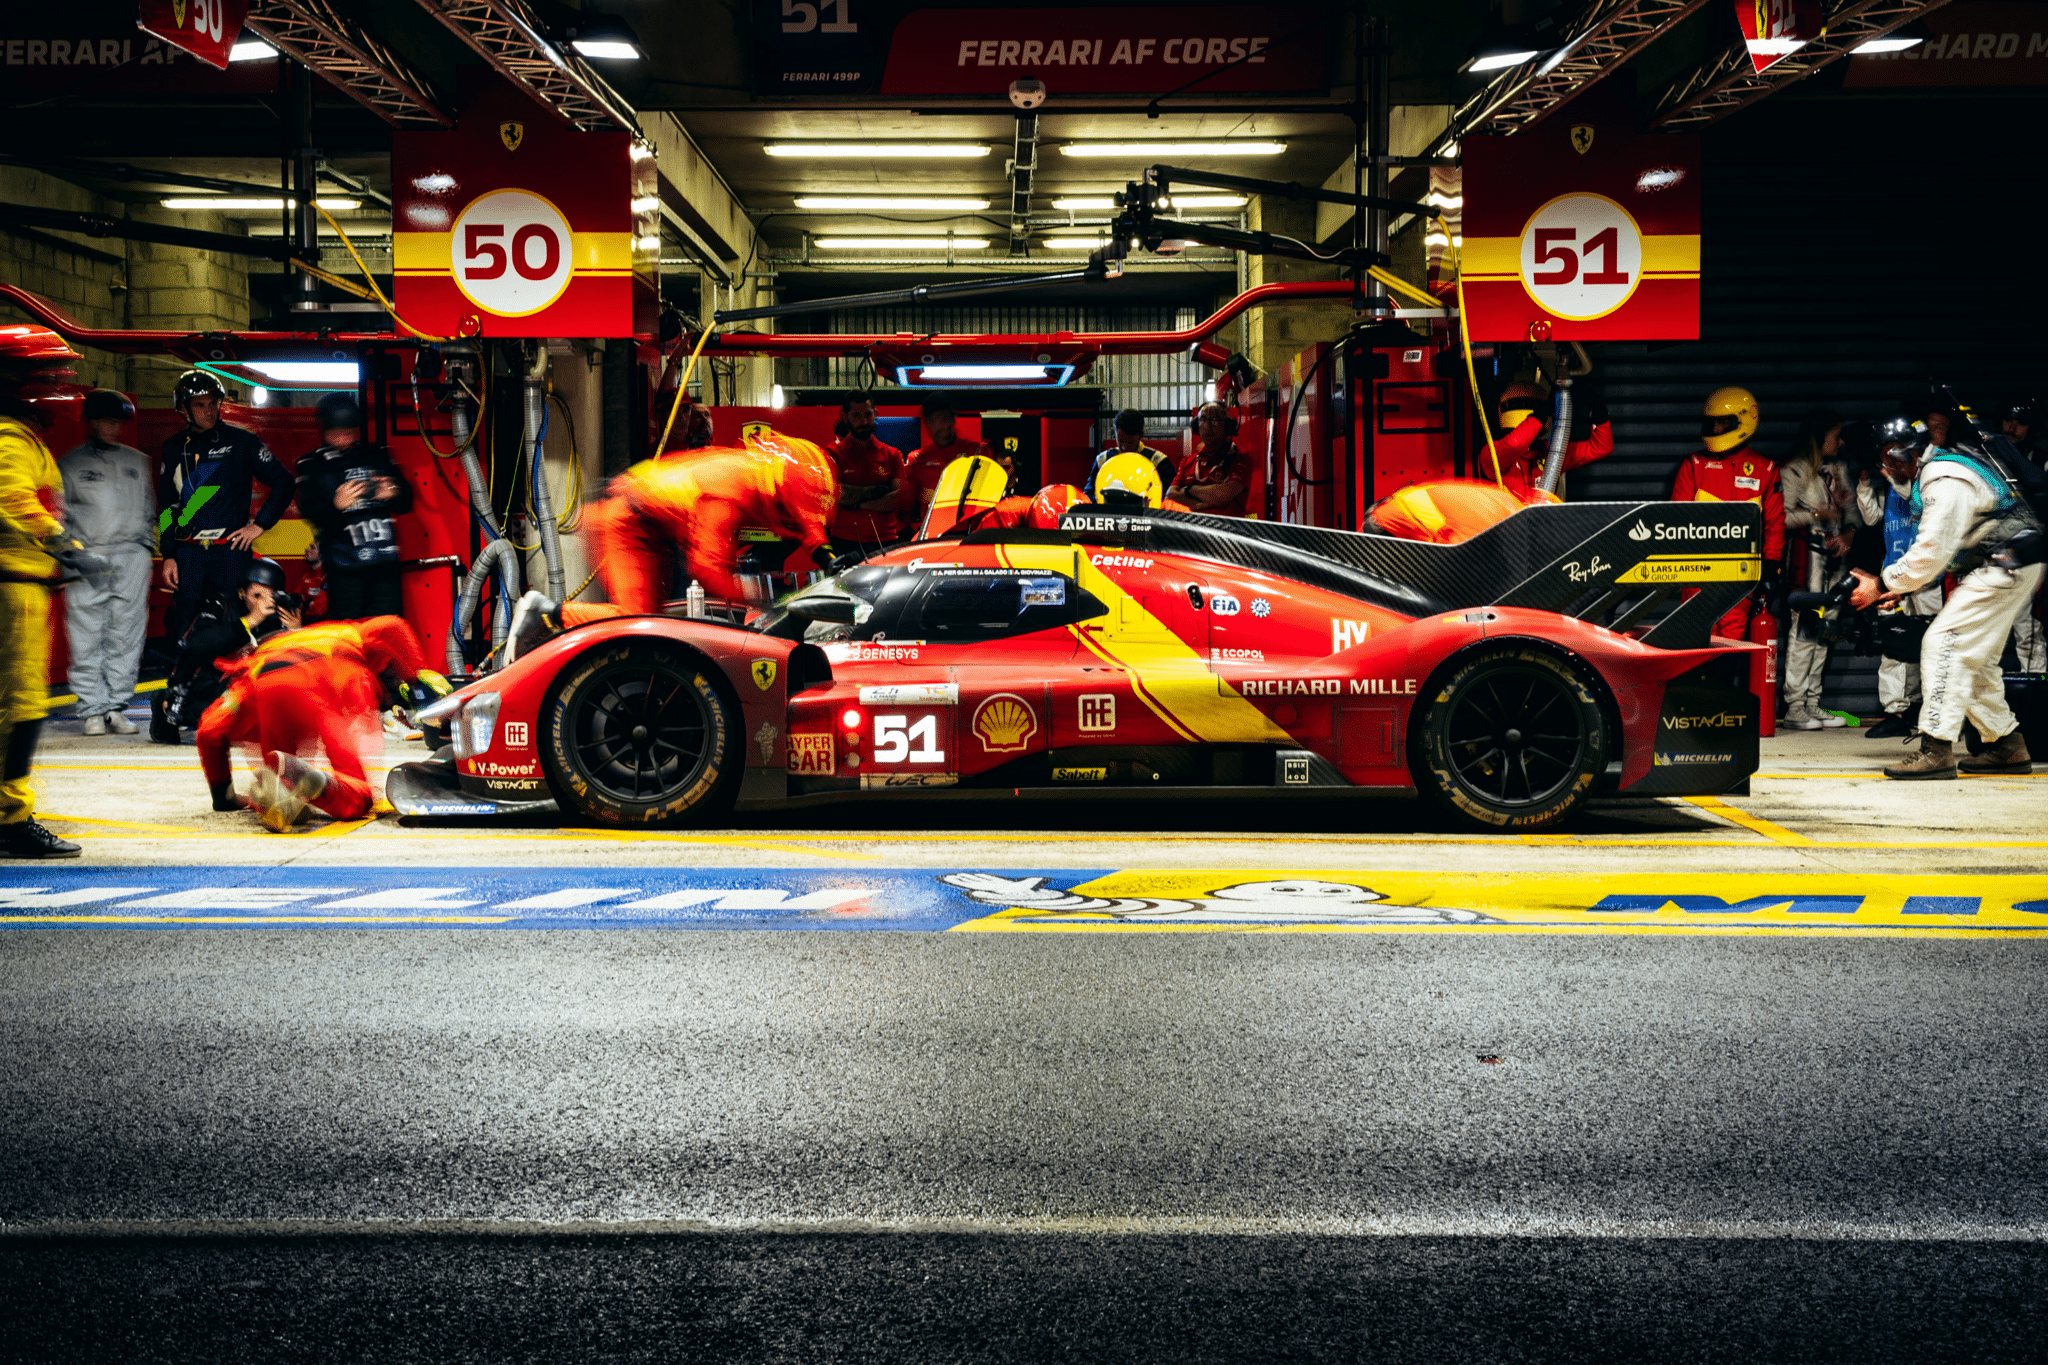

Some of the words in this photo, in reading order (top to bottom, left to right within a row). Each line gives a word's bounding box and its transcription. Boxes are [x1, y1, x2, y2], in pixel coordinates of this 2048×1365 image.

[781, 0, 858, 33] 51
[0, 39, 132, 66] ERRARI
[957, 38, 1104, 66] FERRARI
[1109, 37, 1157, 65] AF
[1163, 36, 1270, 64] CORSE
[782, 72, 830, 81] FERRARI
[832, 72, 861, 81] 499P
[463, 222, 561, 281] 50
[1532, 226, 1630, 286] 51
[1060, 516, 1116, 531] ADLER
[1654, 522, 1750, 540] Santander
[1651, 565, 1673, 573] LARS
[1674, 564, 1706, 573] LARSEN
[1651, 573, 1678, 581] GROUP
[862, 648, 919, 660] GENESYS
[1222, 648, 1265, 659] ECOPOL
[1242, 679, 1341, 696] RICHARD
[1350, 679, 1417, 694] MILLE
[787, 736, 831, 750] HYPER
[874, 714, 945, 763] 51
[787, 751, 832, 771] CAR
[1673, 754, 1732, 762] MICHELIN
[1057, 768, 1100, 780] Sabelt
[1584, 893, 2048, 915] MI
